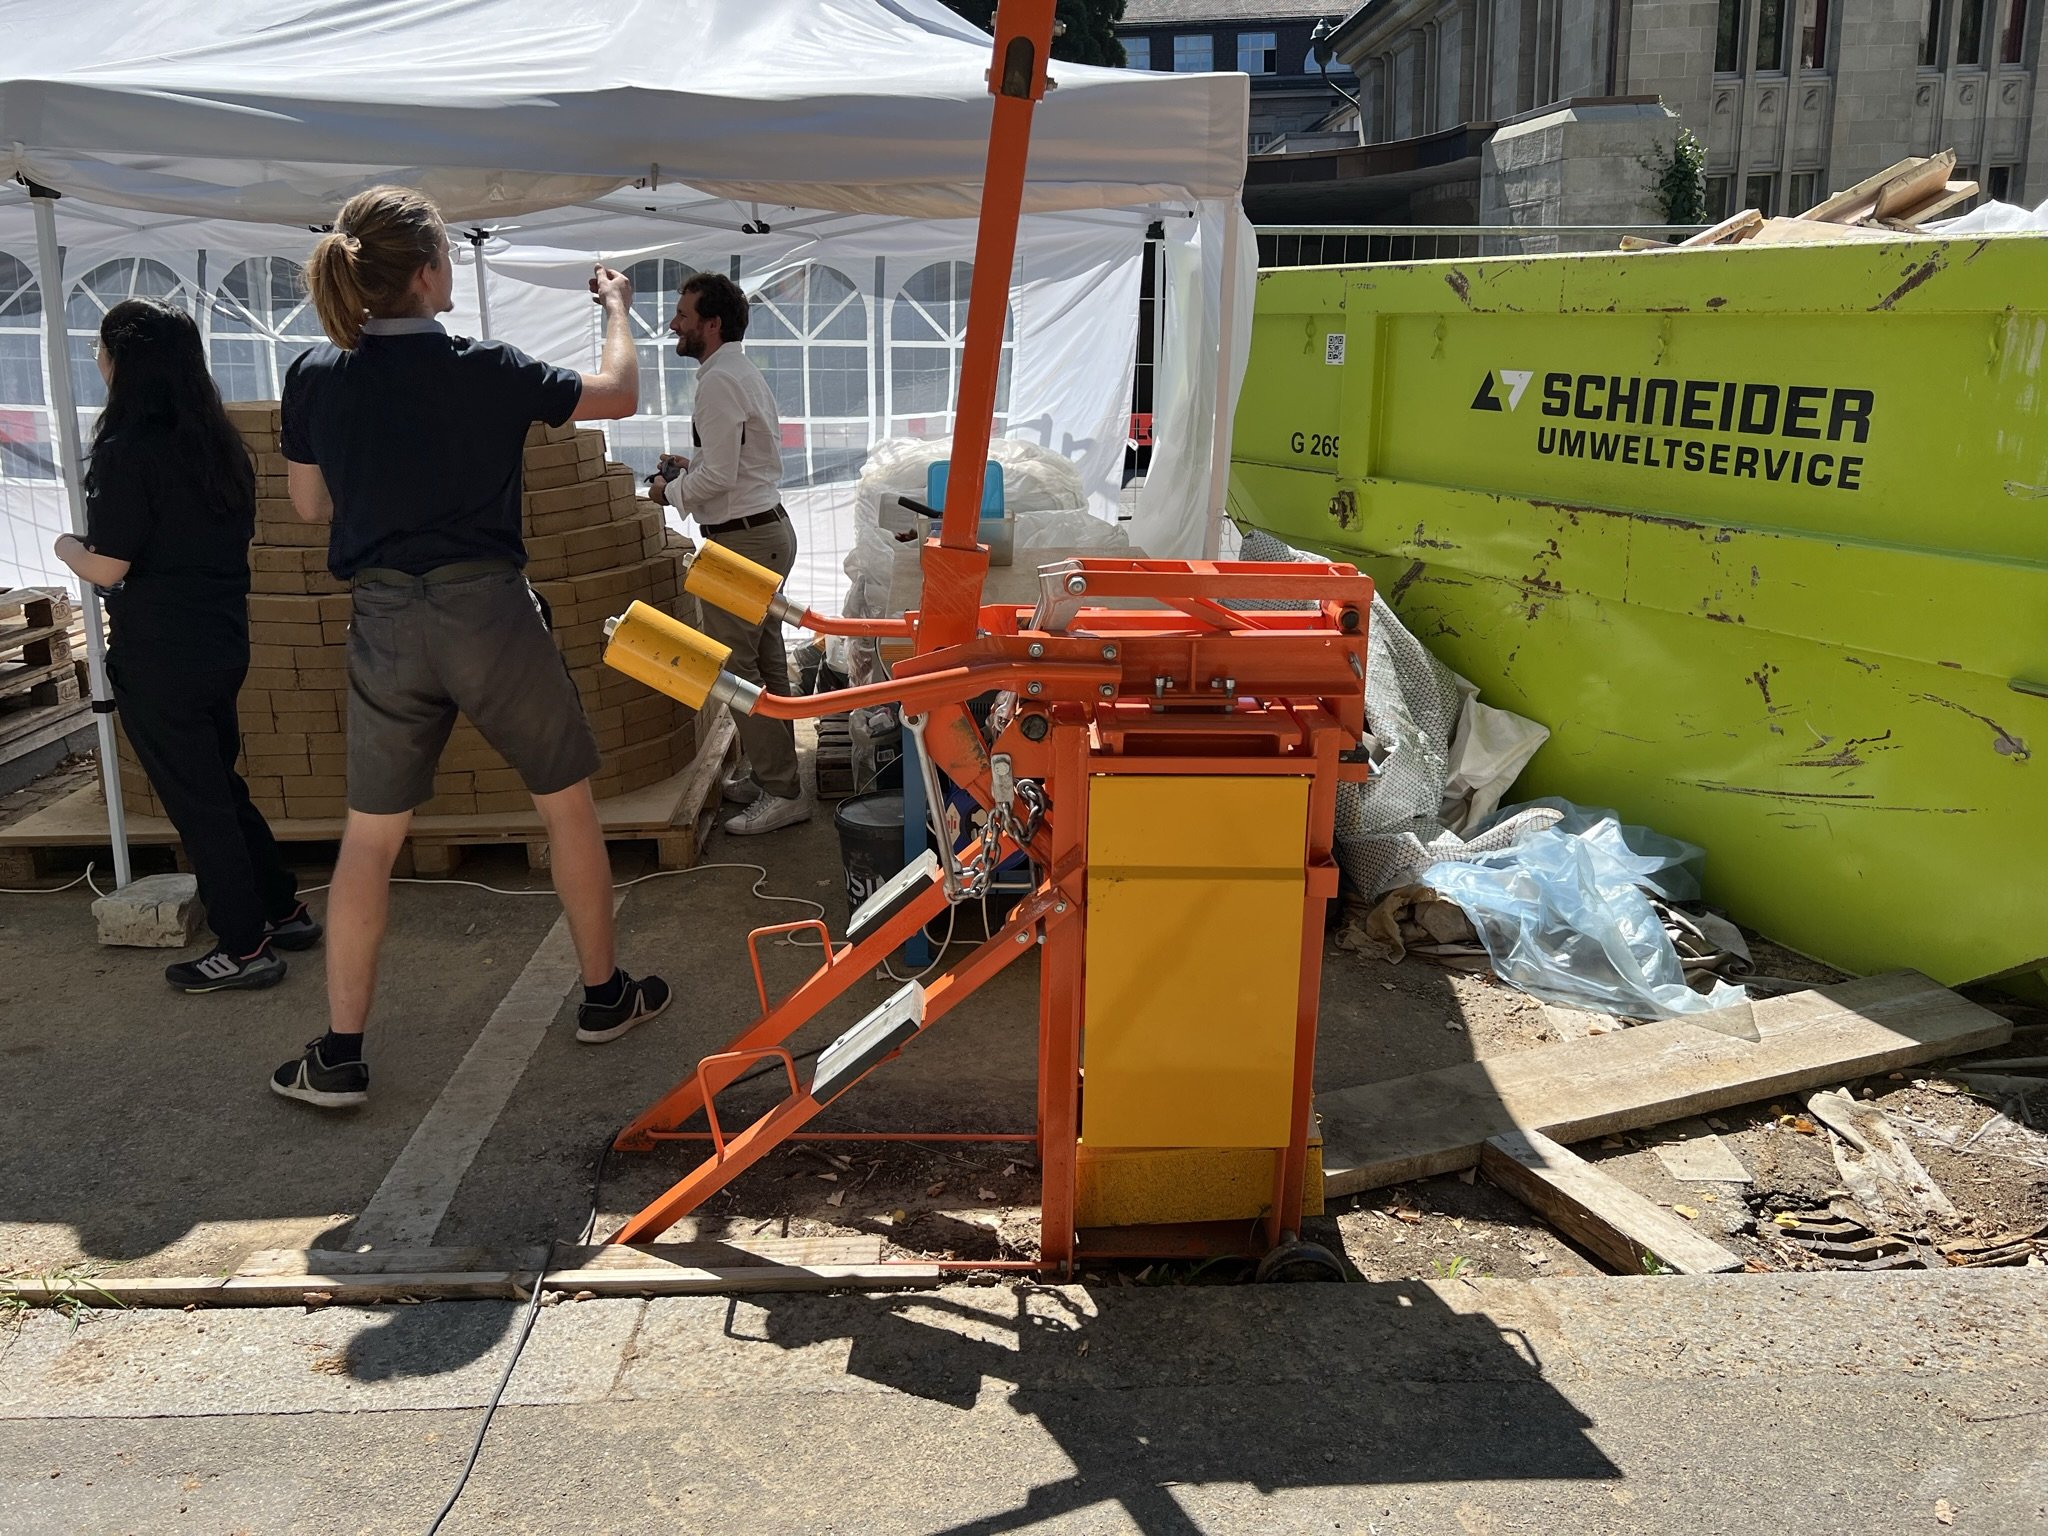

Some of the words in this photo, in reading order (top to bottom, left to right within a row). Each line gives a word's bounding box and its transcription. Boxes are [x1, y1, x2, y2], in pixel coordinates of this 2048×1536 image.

[1134, 418, 1152, 440] L
[1541, 372, 1875, 443] SCHNEIDER
[1291, 432, 1305, 453] G
[1537, 426, 1864, 490] UMWELTSERVICE
